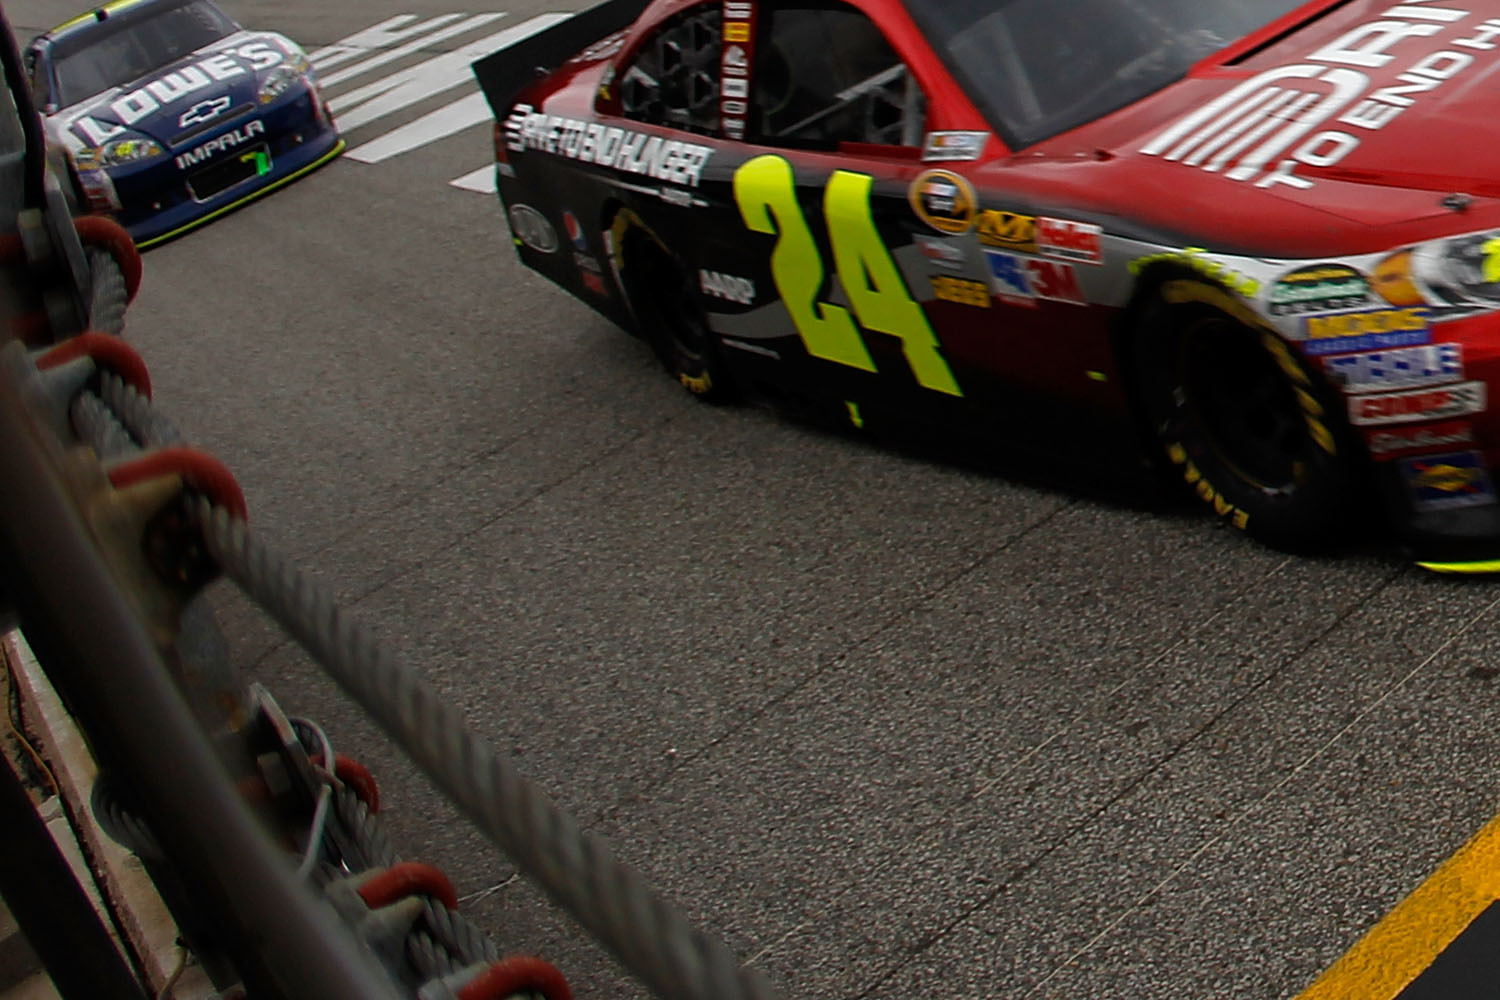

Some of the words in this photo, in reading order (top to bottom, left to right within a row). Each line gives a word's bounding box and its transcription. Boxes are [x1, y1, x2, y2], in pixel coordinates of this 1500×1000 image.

[76, 42, 283, 148] LOWE'S
[174, 119, 265, 170] IMPALA
[1254, 130, 1363, 190] TO
[1339, 50, 1475, 130] END
[732, 155, 965, 398] 24
